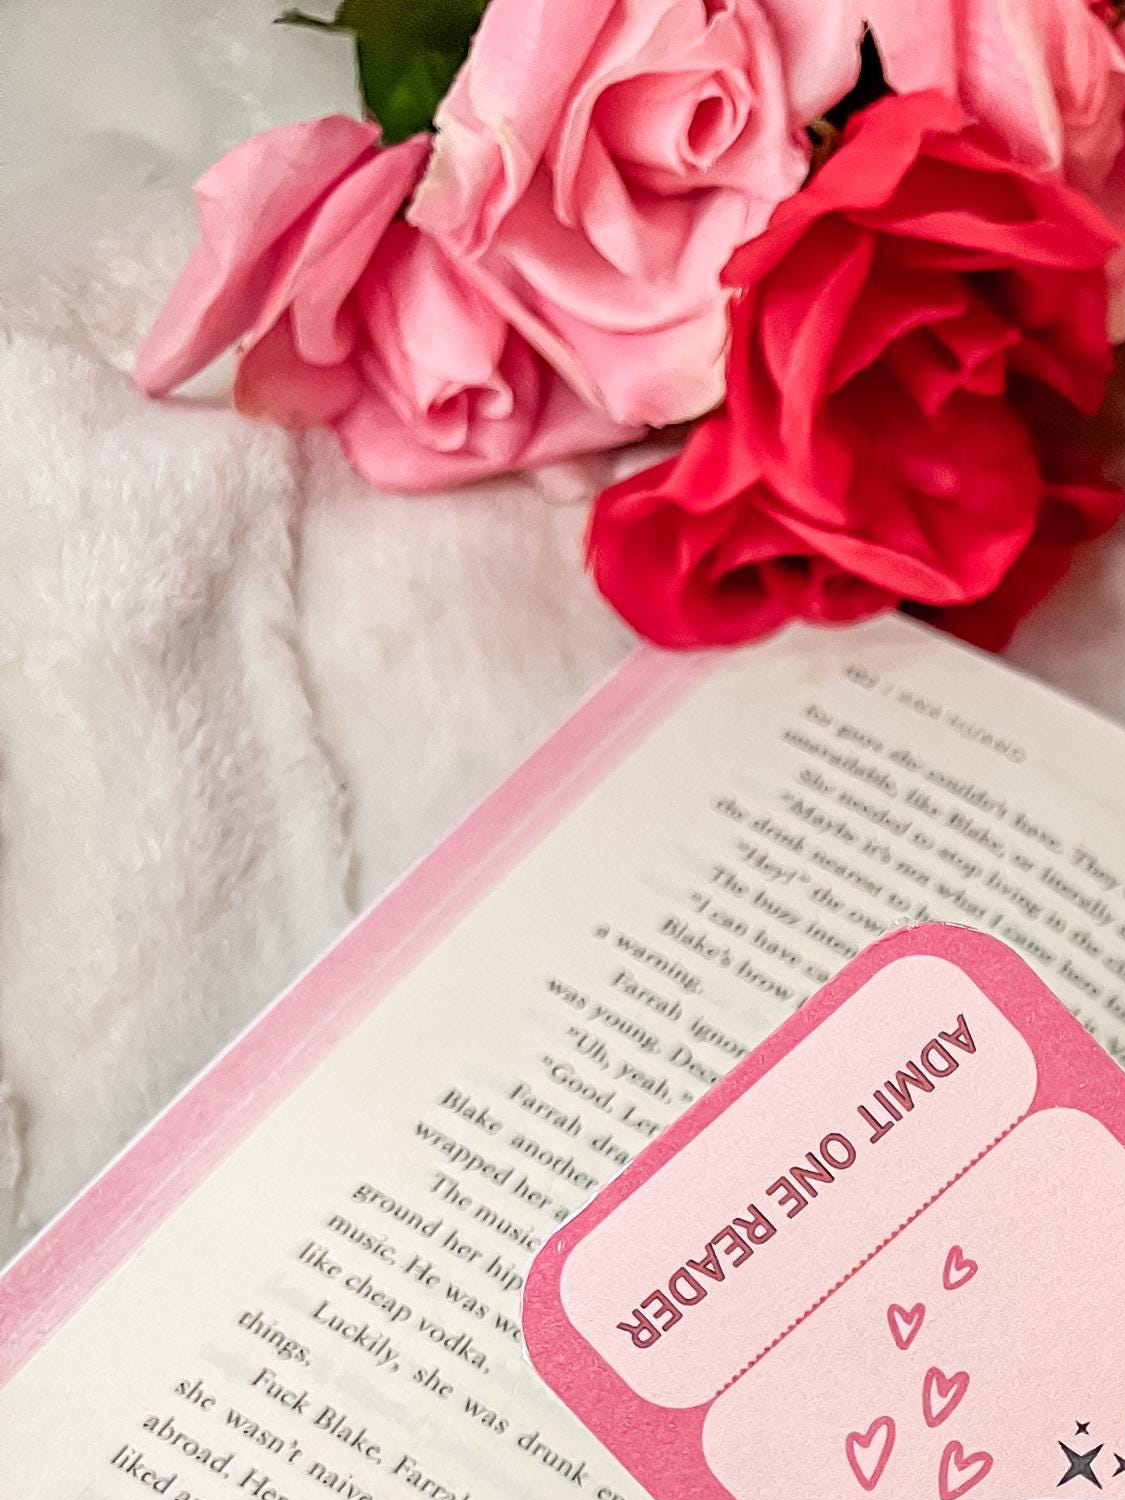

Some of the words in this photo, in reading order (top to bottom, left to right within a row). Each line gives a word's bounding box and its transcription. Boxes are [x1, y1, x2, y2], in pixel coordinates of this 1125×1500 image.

[707, 911, 750, 937] can
[752, 928, 803, 968] have
[708, 864, 751, 899] The
[749, 889, 802, 929] buzz
[658, 916, 732, 968] Blake's
[546, 977, 588, 1010] was
[667, 1044, 720, 1086] Dece
[610, 969, 683, 1022] Farrah
[688, 1017, 748, 1059] ignor
[857, 1013, 977, 1144] ADMIT
[414, 1120, 516, 1187] wrapped
[510, 1175, 554, 1210] her
[437, 1087, 504, 1136] Blake
[507, 1134, 600, 1191] another
[506, 1082, 582, 1138] Farrah
[588, 1133, 630, 1169] dra
[429, 1171, 473, 1211] The
[472, 1204, 542, 1253] music
[765, 1132, 857, 1219] ONE
[296, 1240, 343, 1280] like
[343, 1274, 413, 1323] cheap
[350, 1184, 444, 1239] ground
[439, 1228, 484, 1264] her
[483, 1254, 524, 1293] hip
[616, 1203, 777, 1349] READER
[402, 1254, 441, 1290] He
[445, 1281, 490, 1320] was
[236, 1310, 312, 1367] things.
[173, 1379, 217, 1412] she
[224, 1407, 303, 1463] wasn't
[249, 1366, 311, 1416] Fuck
[312, 1404, 382, 1466] Blake,
[309, 1299, 400, 1373] Luckily,
[411, 1367, 454, 1399] she
[463, 1396, 510, 1435] was
[516, 1430, 589, 1489] drunk
[109, 1443, 179, 1496] liked
[142, 1415, 236, 1480] abroad.
